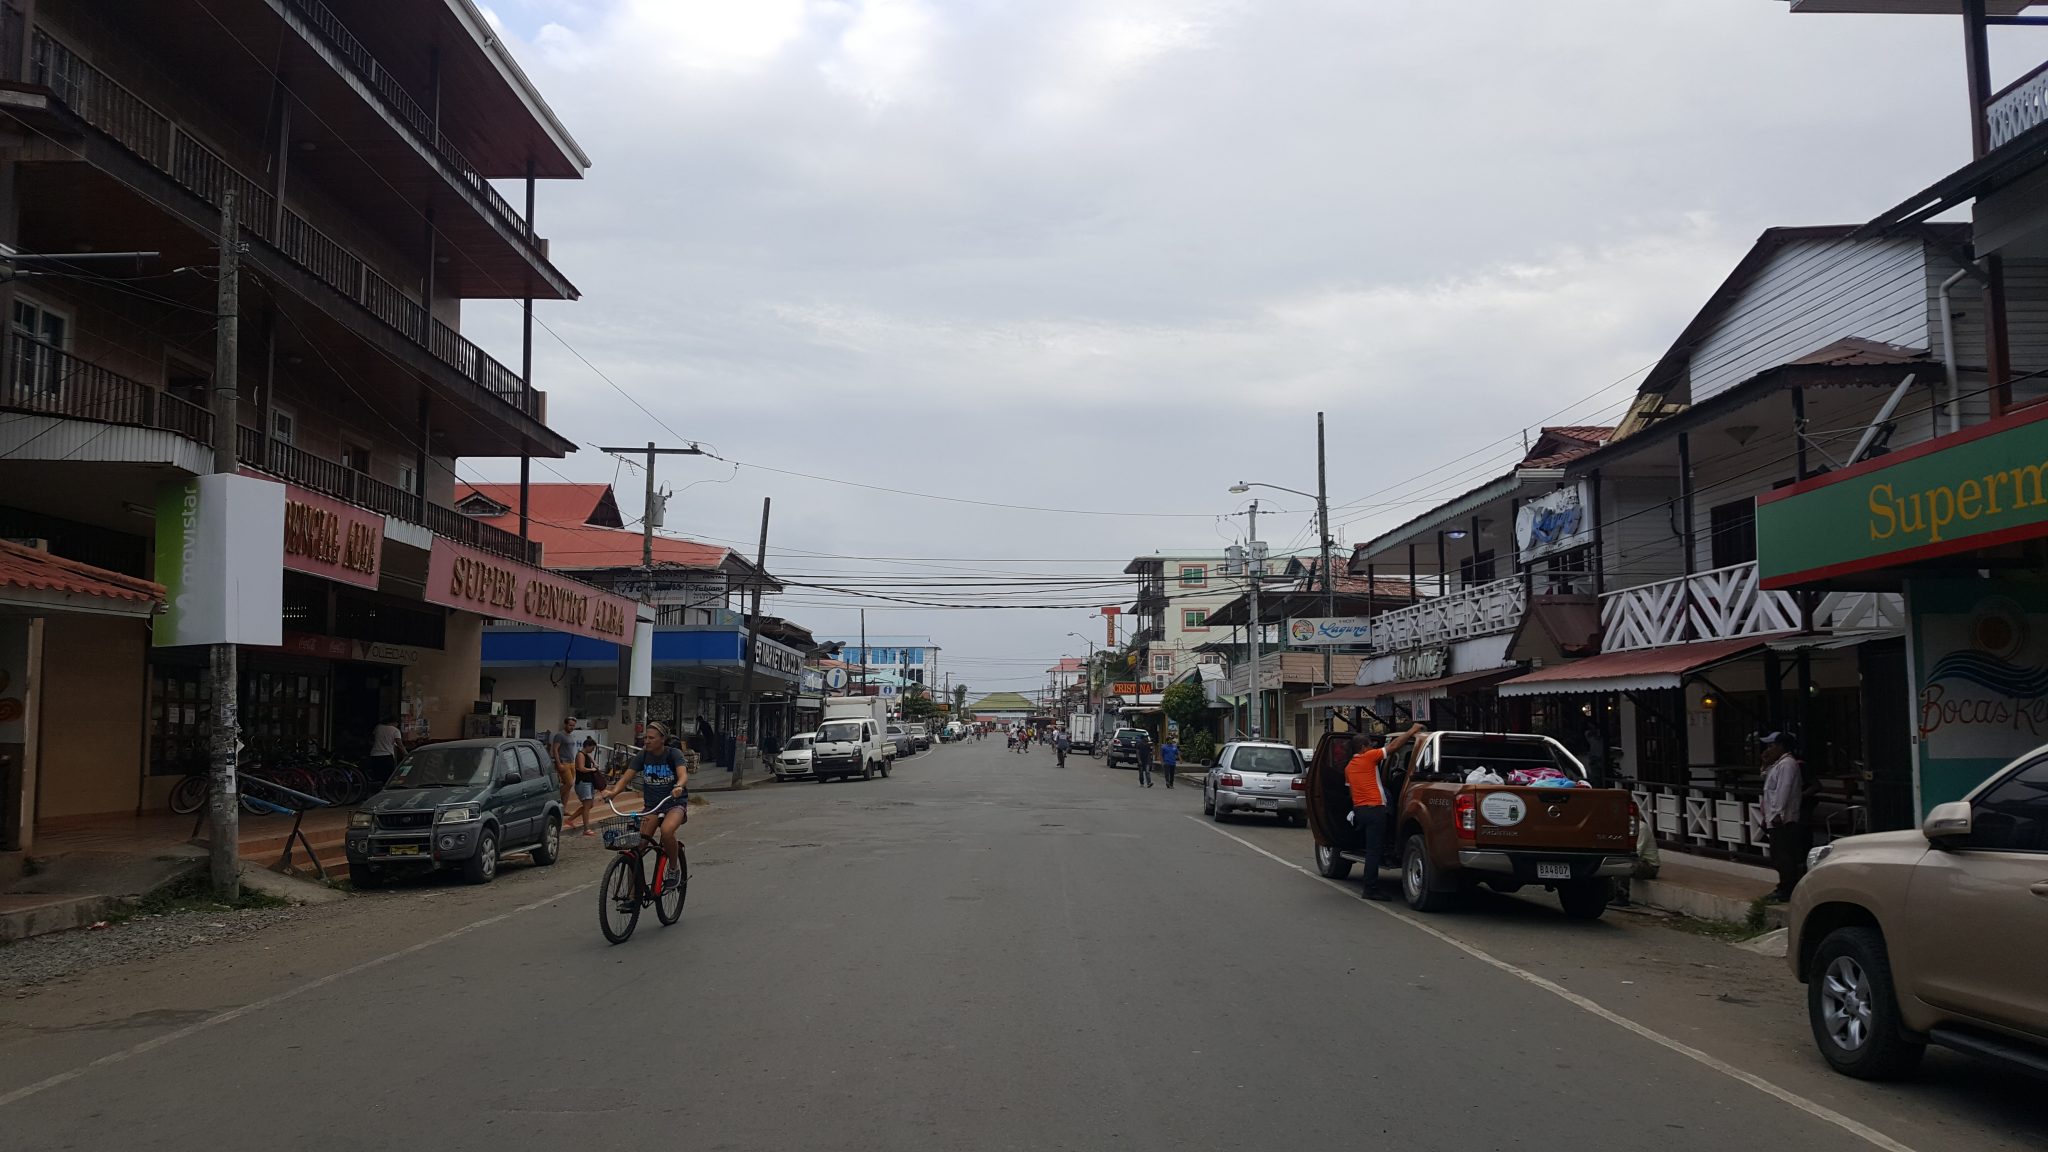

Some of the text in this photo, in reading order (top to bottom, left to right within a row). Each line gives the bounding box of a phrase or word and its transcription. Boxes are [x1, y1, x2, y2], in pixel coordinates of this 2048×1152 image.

[1868, 461, 2048, 543] Superm
[182, 485, 199, 586] movistar
[342, 519, 377, 575] ALBA
[450, 555, 625, 637] SUPER CENTRO ALBA
[1318, 622, 1368, 639] Laguna
[1113, 682, 1152, 694] CRISTNA
[1919, 684, 2010, 739] Bocas
